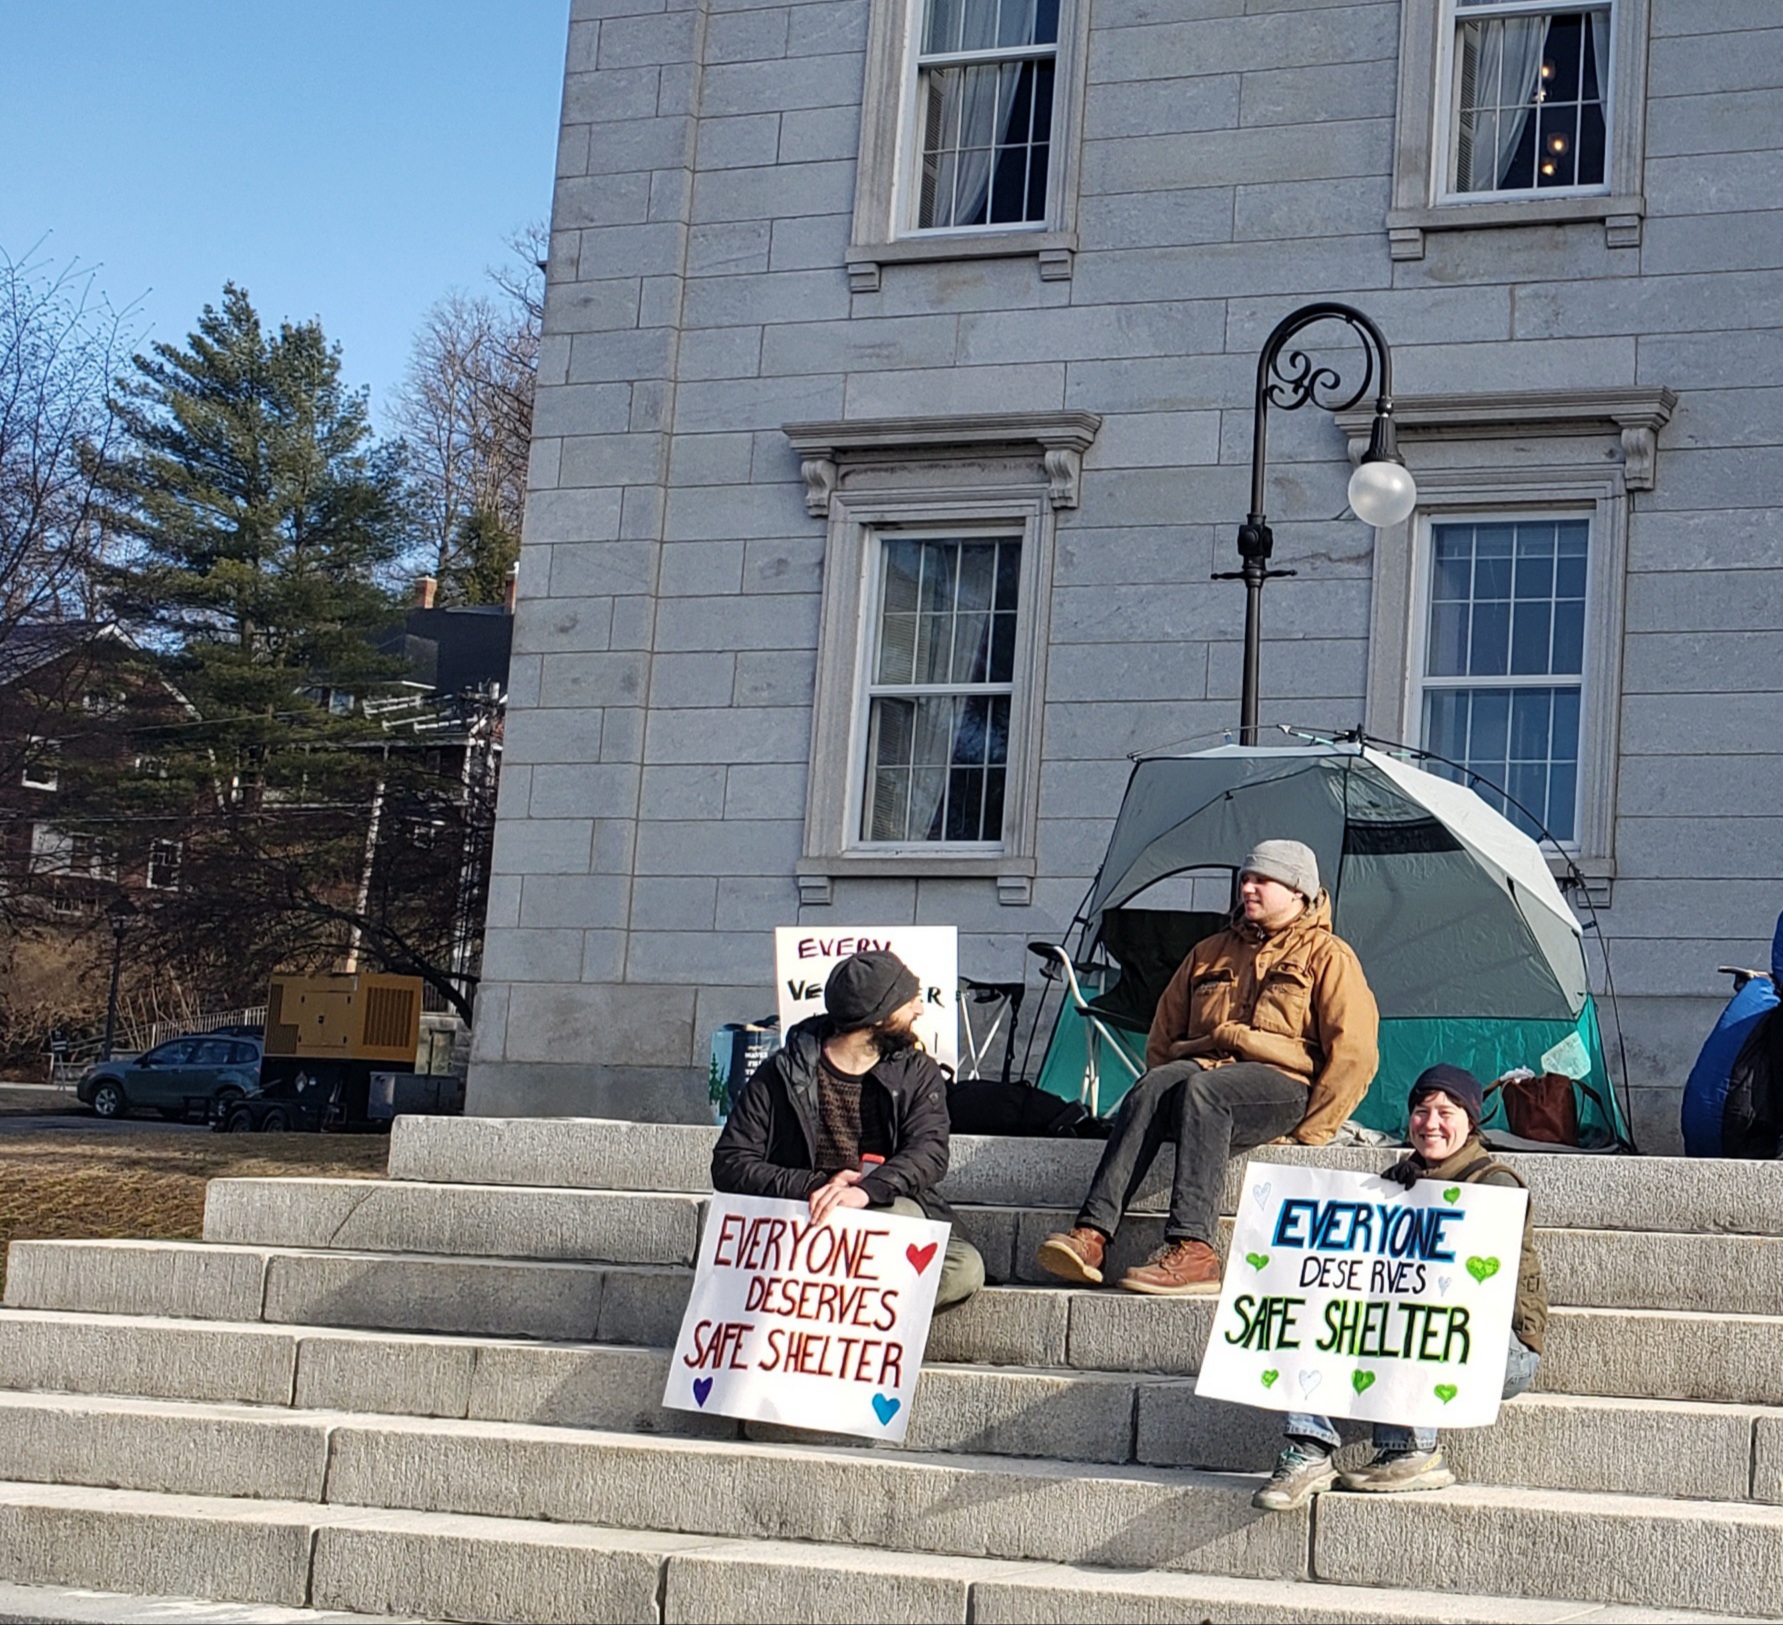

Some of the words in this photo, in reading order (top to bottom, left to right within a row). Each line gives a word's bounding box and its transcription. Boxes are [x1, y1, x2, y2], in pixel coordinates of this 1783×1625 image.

[714, 1213, 889, 1281] EVERYONE
[1271, 1198, 1465, 1263] EVERYONE
[744, 1274, 899, 1332] DESERVES
[1224, 1294, 1306, 1352] SAFE
[1315, 1299, 1470, 1364] SHELTER
[683, 1319, 755, 1370] SAFE
[757, 1328, 904, 1389] SHELTER
